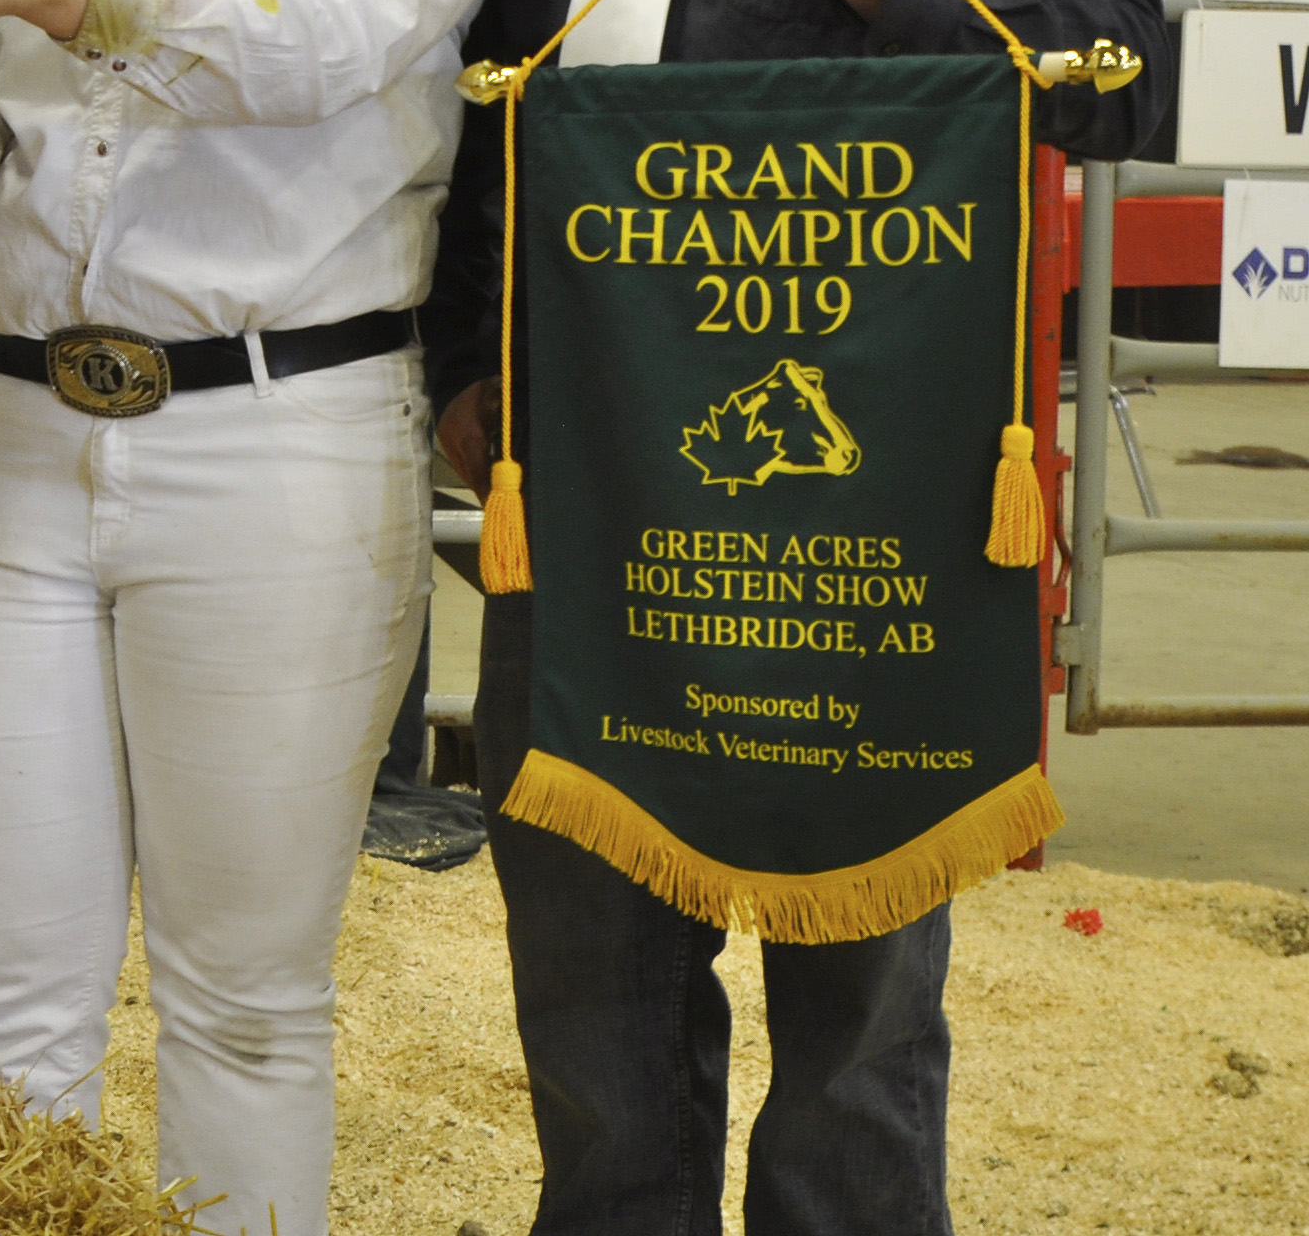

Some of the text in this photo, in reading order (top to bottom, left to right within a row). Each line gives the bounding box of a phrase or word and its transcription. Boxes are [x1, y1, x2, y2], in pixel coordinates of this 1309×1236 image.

[635, 140, 914, 200] GRAND
[566, 202, 976, 267] CHAMPION
[696, 274, 852, 335] 2019
[641, 528, 902, 569] GREEN ACRES
[626, 561, 928, 607] HOLSTEIN SHOW
[628, 606, 936, 658] LETHBRIDGE, AB
[686, 684, 860, 729] Sponsored by
[602, 715, 973, 774] Livestock Veterinary Services
